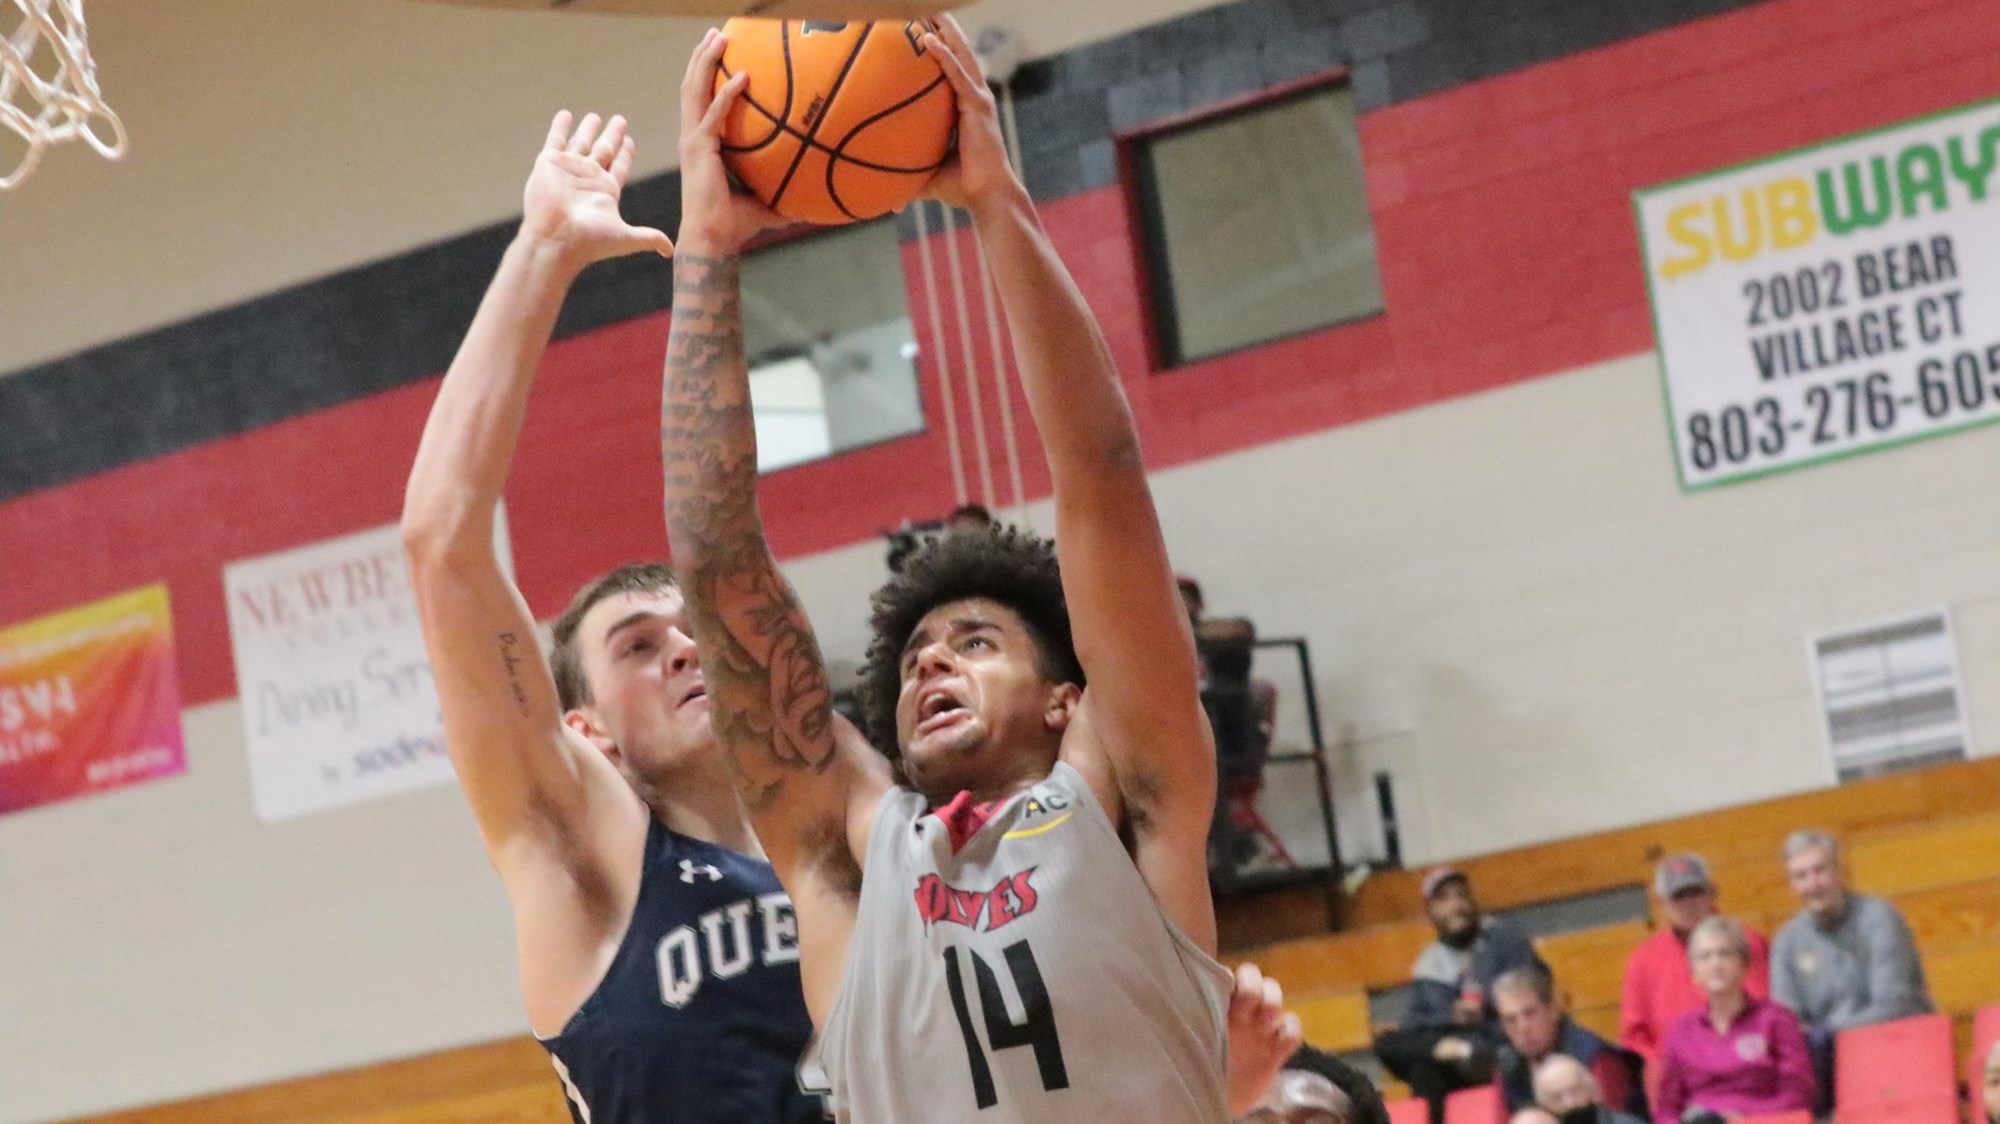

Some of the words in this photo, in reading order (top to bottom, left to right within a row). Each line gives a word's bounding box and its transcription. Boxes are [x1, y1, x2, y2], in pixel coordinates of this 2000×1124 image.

[1658, 125, 2000, 279] SUBWAY
[1742, 260, 1846, 328] 2002
[1855, 233, 1958, 300] BEAR
[1749, 304, 1906, 382] VILLAGE
[1915, 290, 1964, 345] CT
[237, 552, 411, 625] NEWBE
[655, 891, 800, 1011] QUE
[943, 938, 1070, 1111] 14
